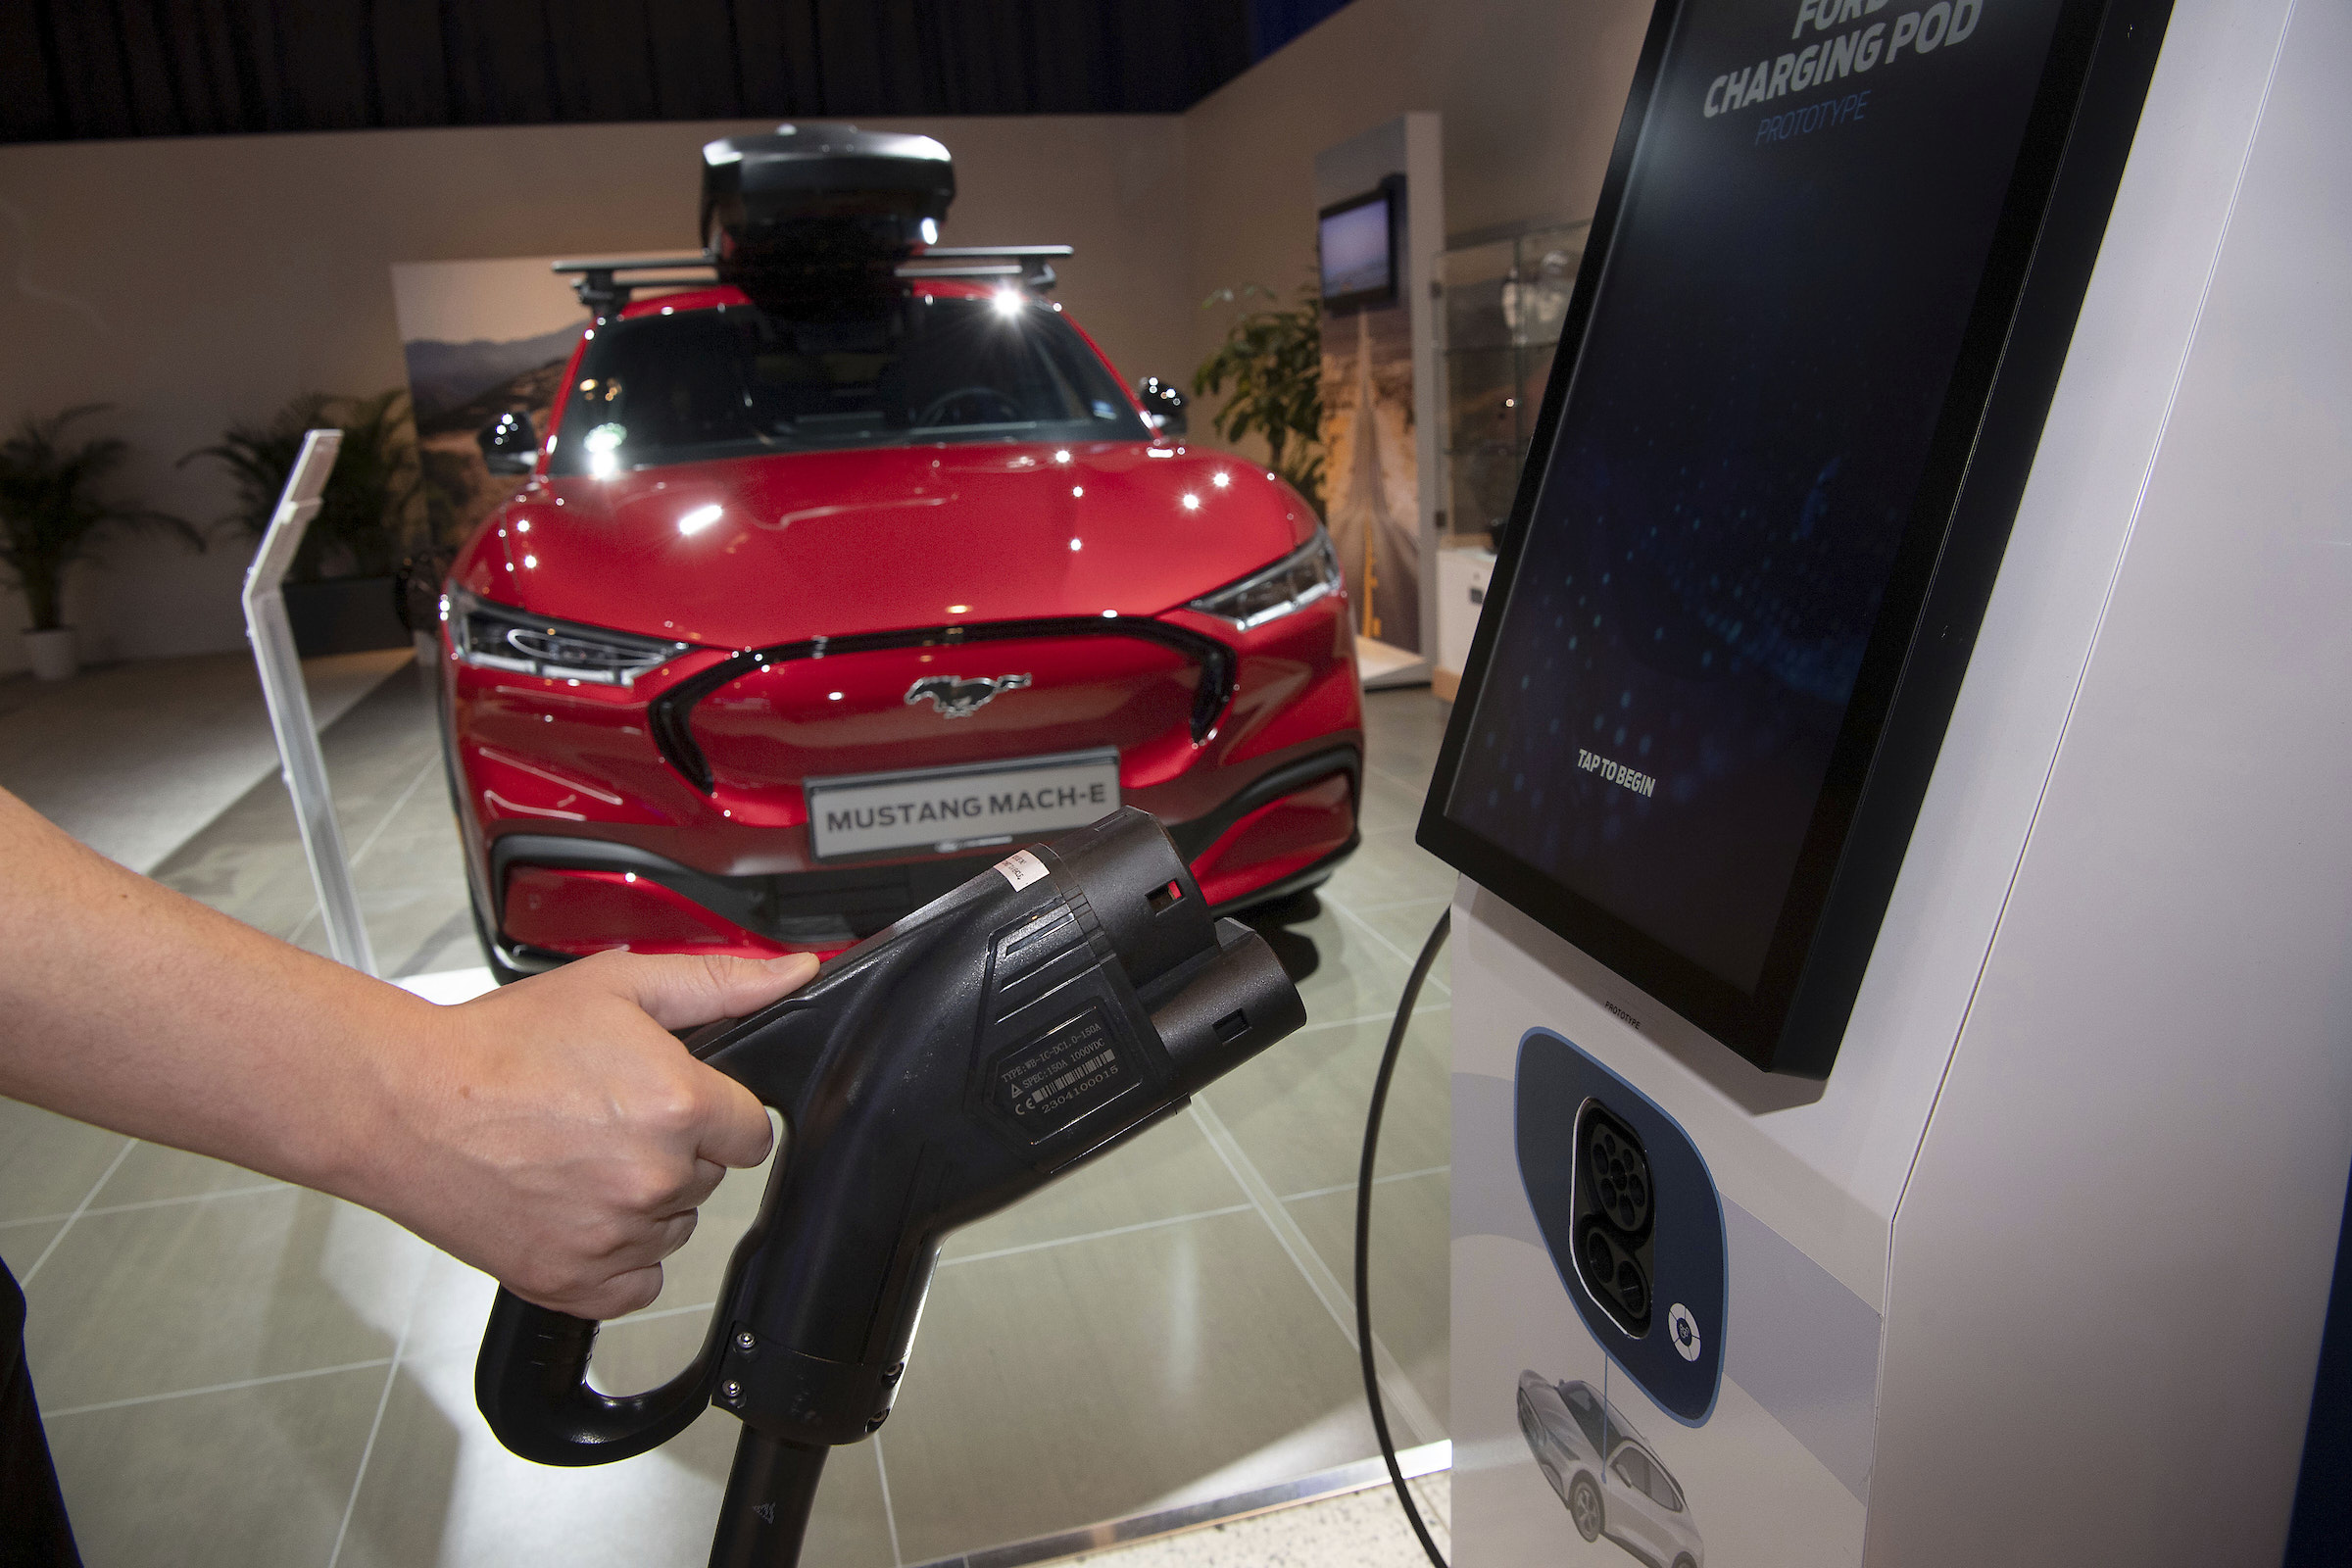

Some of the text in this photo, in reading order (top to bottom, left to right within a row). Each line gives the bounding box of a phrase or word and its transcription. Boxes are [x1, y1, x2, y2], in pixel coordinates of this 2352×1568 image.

[1703, 0, 1984, 119] CHARGING POD
[1755, 90, 1872, 146] PROTOTYPE
[1577, 748, 1656, 798] TAP TO BEGIN
[827, 783, 1106, 833] MUSTANG MACH-E
[1604, 1001, 1641, 1030] PROTOTYPE
[1022, 1038, 1105, 1089] SPEC:150A 1000VDC
[1014, 1098, 1036, 1115] CE
[1041, 1064, 1119, 1114] 2304100015
